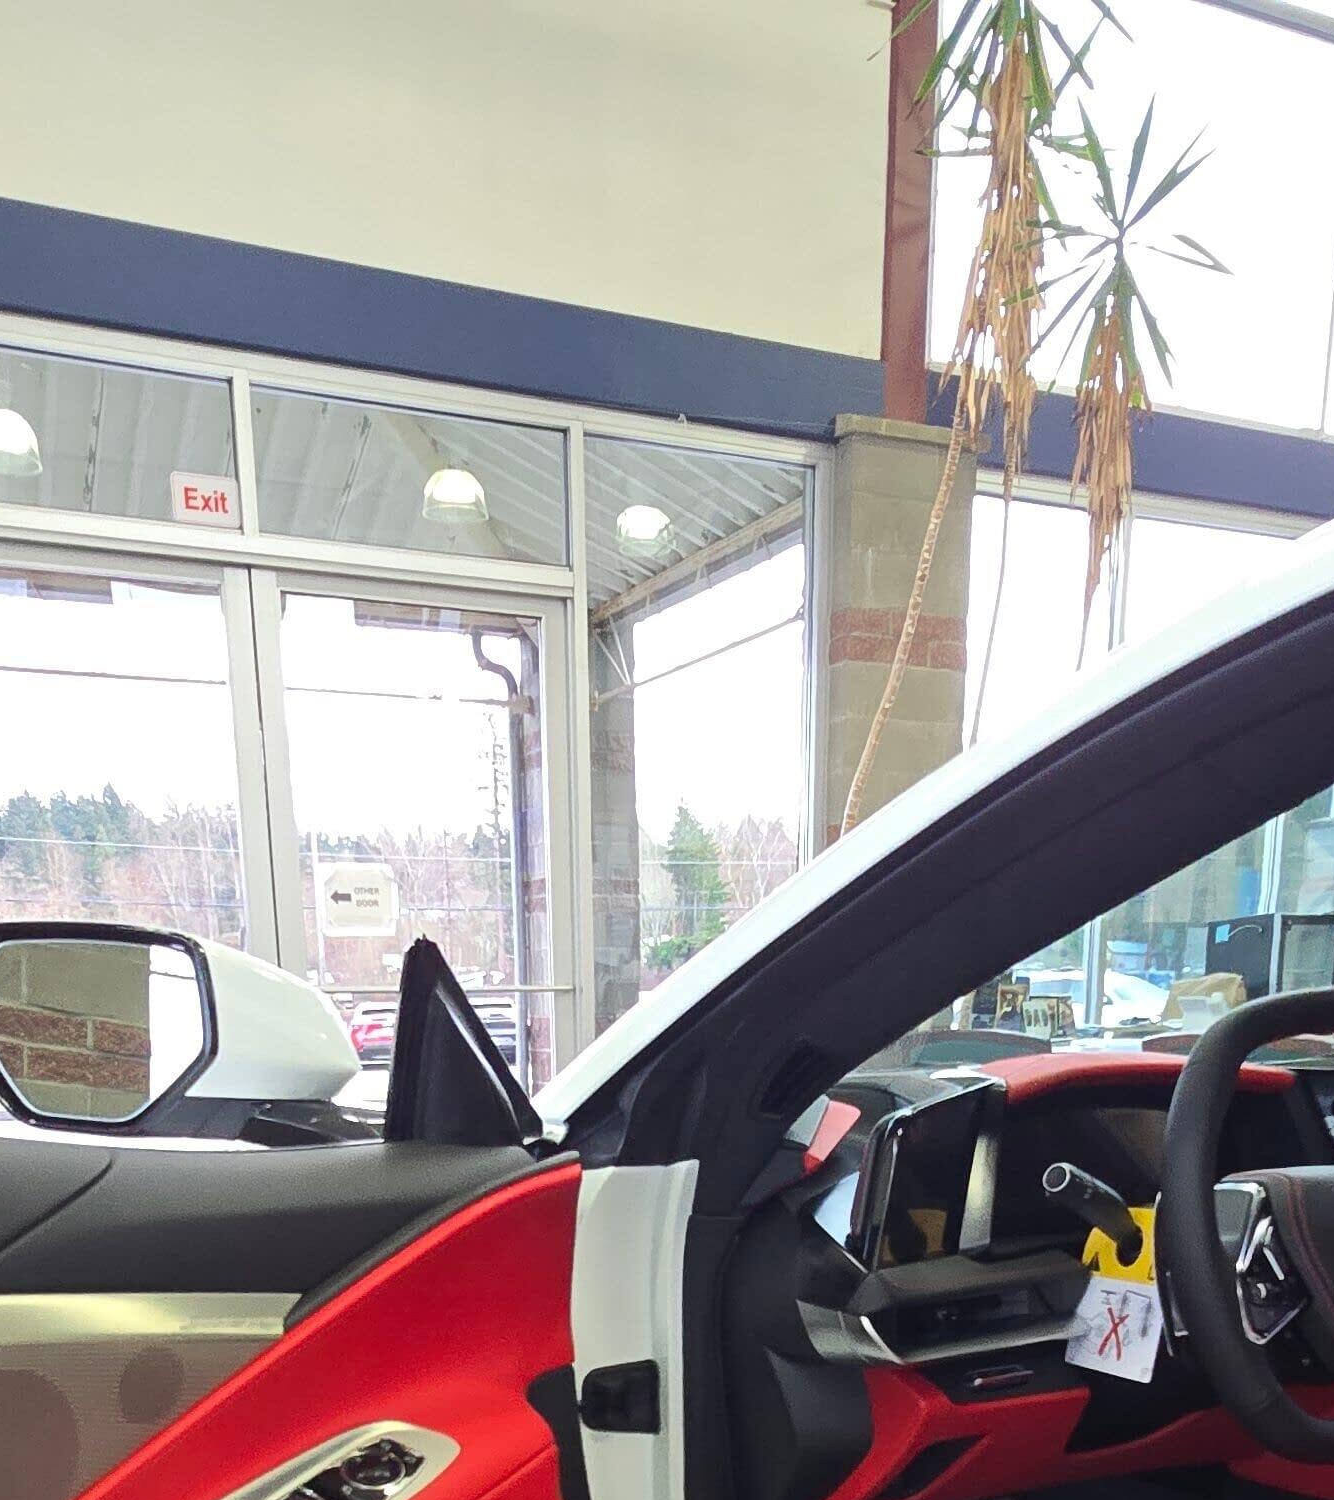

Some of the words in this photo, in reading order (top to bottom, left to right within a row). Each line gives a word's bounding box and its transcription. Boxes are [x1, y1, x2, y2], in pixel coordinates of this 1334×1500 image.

[183, 486, 229, 514] Exit
[354, 886, 380, 896] OTHER
[356, 899, 380, 908] DOOR
